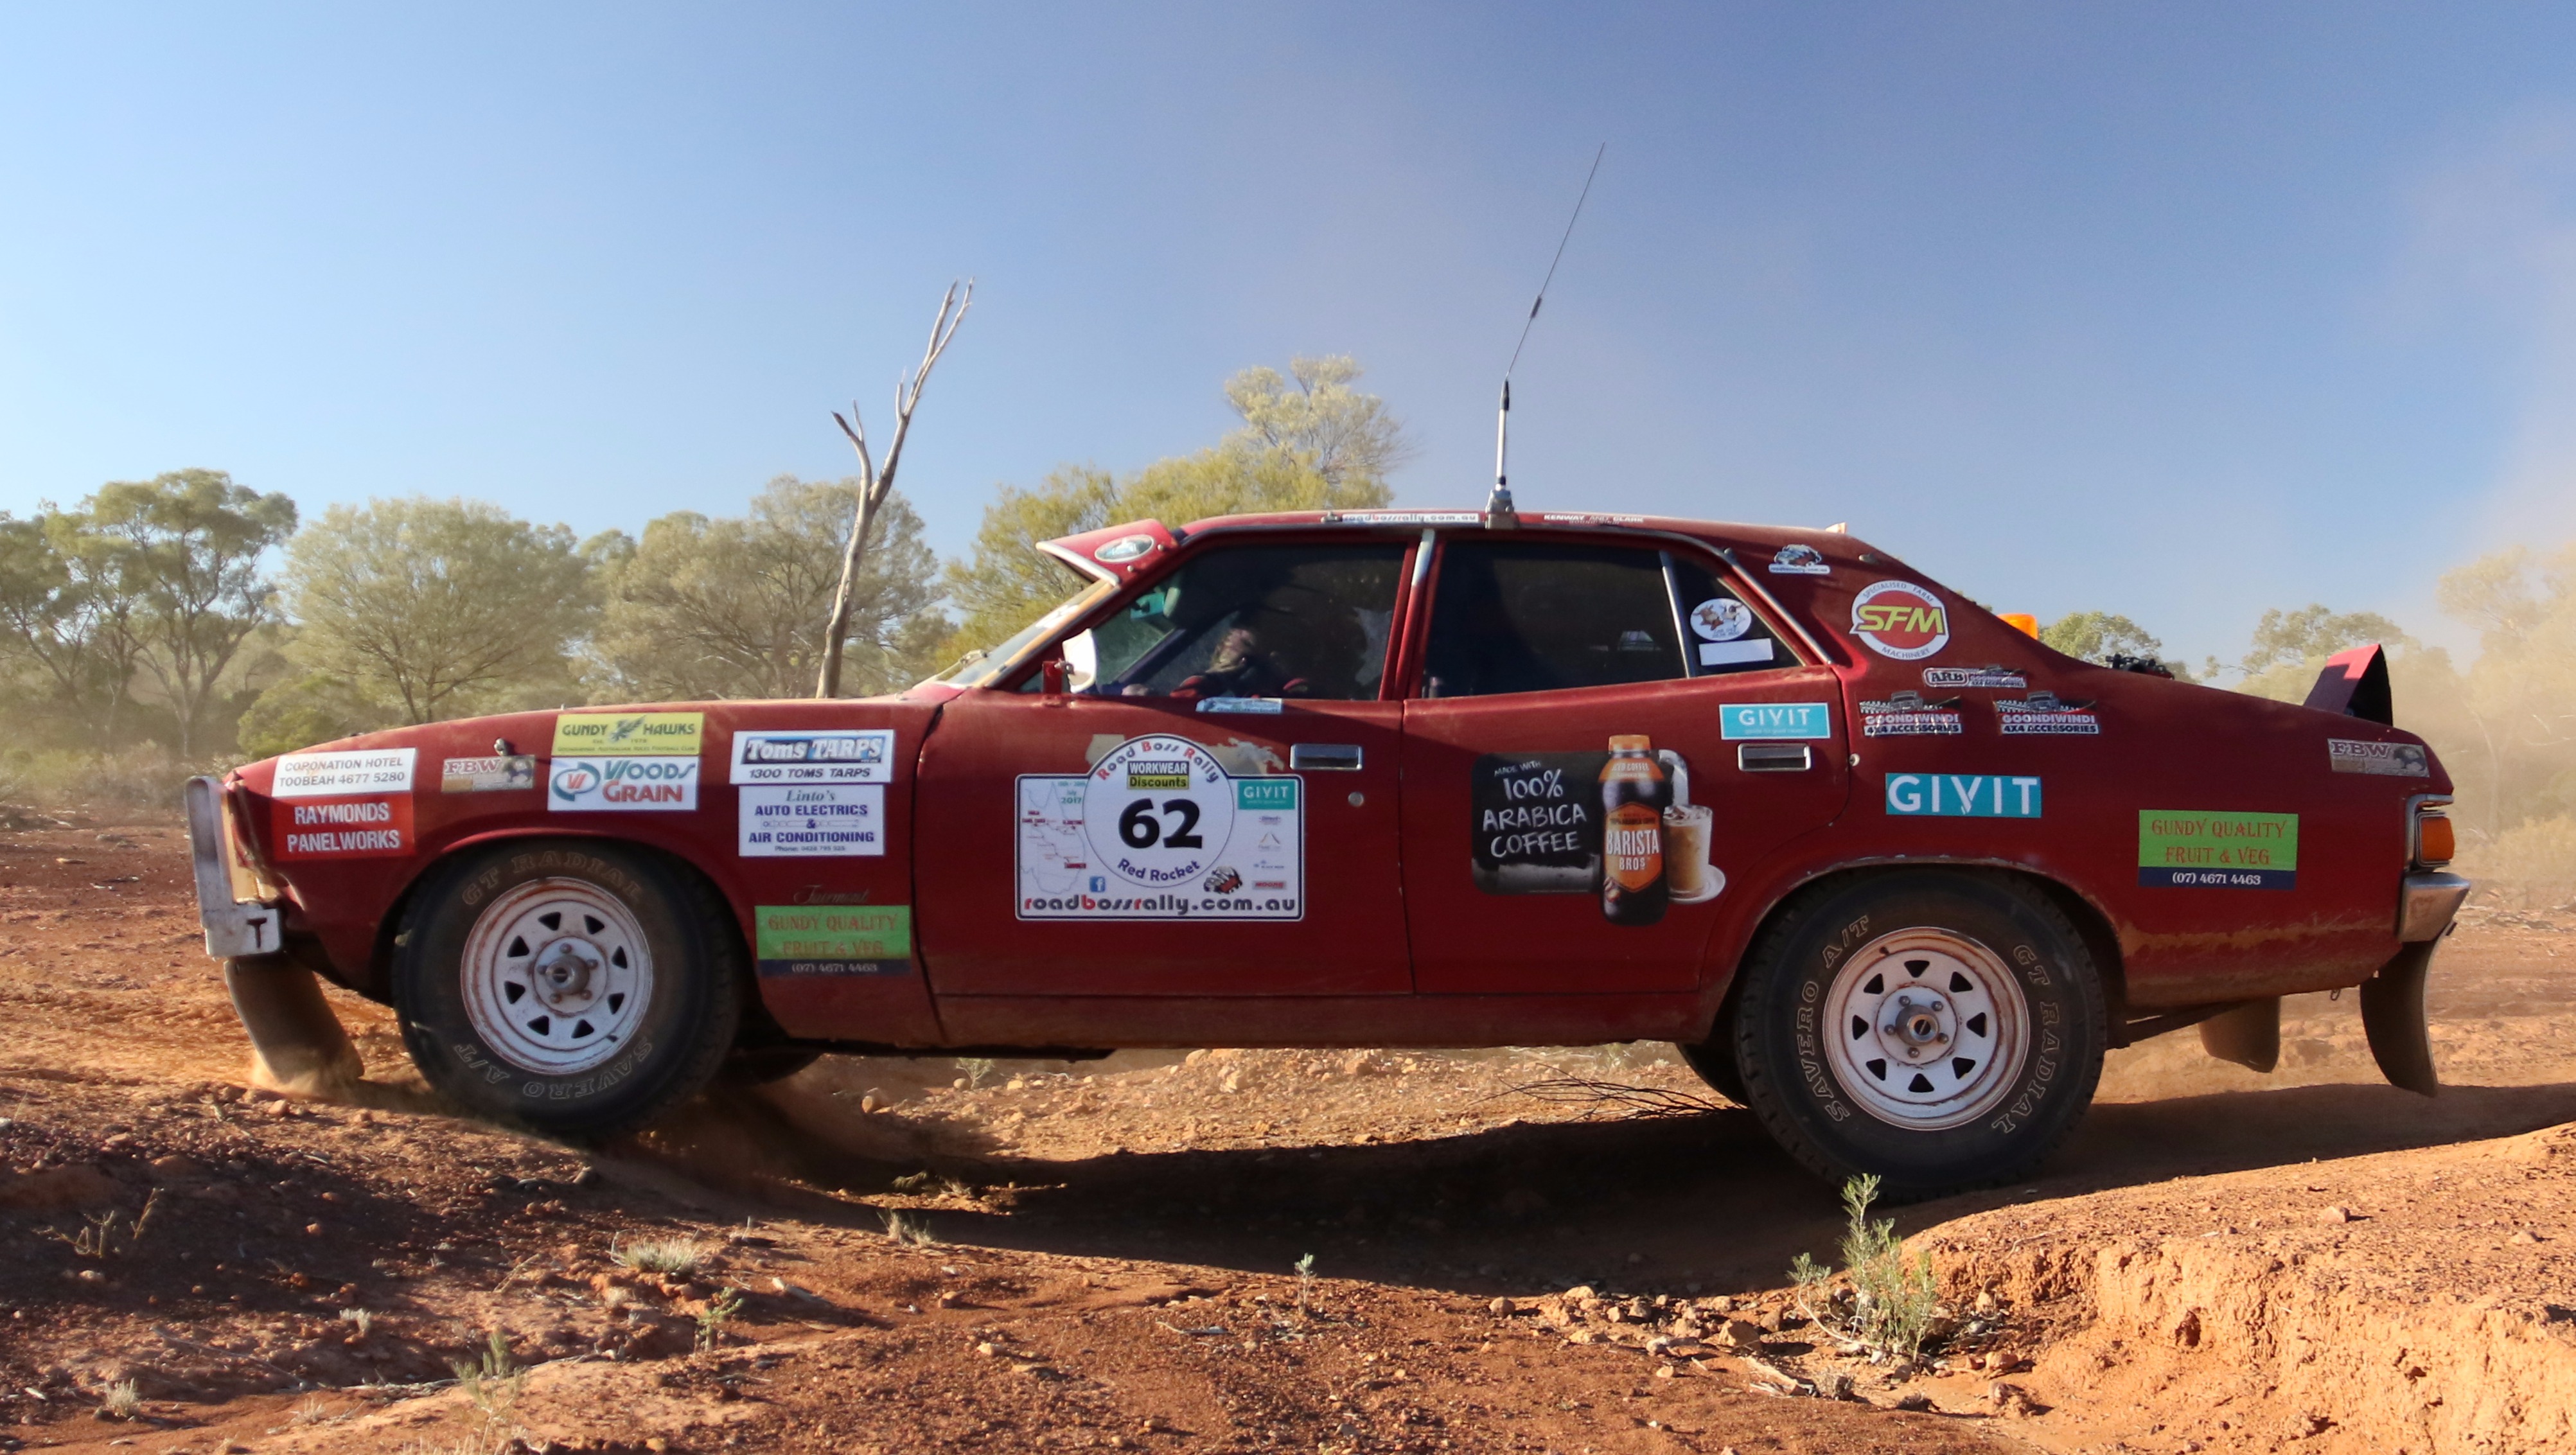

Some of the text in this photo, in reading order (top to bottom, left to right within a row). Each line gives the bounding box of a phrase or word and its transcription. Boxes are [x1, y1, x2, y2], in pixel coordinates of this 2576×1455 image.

[1863, 582, 1935, 602] SPECIALISED FARM
[1857, 604, 1945, 634] SFM
[1882, 646, 1930, 659] MACHINERY
[1930, 672, 1964, 683] ARB
[1738, 708, 1811, 727] GIVIT
[1865, 714, 1959, 724] GOONDIWINDI
[2002, 714, 2095, 724] GOONDIWINDI
[562, 724, 608, 736] GUNDY
[1867, 725, 1959, 734] 4X4 ACCESSORIES
[2027, 725, 2097, 734] ACCESSORIES
[746, 737, 883, 761] Toms TARPS
[2331, 741, 2389, 758] FBW
[285, 757, 403, 772] CORONATION HOTEL
[445, 758, 501, 775] FBW
[603, 760, 696, 780] WOODS
[1096, 741, 1220, 783] Road Boss Rally
[1129, 761, 1188, 775] WORKWEAR
[1494, 761, 1541, 777] MADE WITH
[279, 772, 405, 788] TOOBEAH 4677 5280
[750, 768, 870, 779] 1300 TOMS TARPS
[1129, 776, 1187, 788] Discounts
[603, 779, 684, 802] GRAIN
[1243, 786, 1289, 798] GIVIT
[1503, 769, 1564, 800] 100%
[786, 789, 835, 802] Linto's
[1888, 774, 2038, 816] GIVIT
[294, 802, 390, 824] RAYMONDS
[754, 805, 868, 816] AUTO ELECTRICS
[1483, 803, 1587, 832] ARABICA
[806, 818, 816, 829] &
[1118, 797, 1203, 850] 62
[2152, 818, 2288, 838] GUNDY QUALITY
[287, 829, 400, 853] PANELWORKS
[748, 832, 874, 843] AIR CONDITIONING
[1490, 831, 1582, 858] COFFEE
[1607, 829, 1660, 856] BARISTA
[1618, 856, 1646, 871] BROS
[2166, 846, 2270, 865] FRUIT & VEG
[462, 849, 642, 906] GT RADIAL
[1118, 858, 1201, 882] Red Rocket
[2172, 871, 2261, 885] (07) 4671 4463
[1024, 894, 1296, 915] roadbossrally.com.au
[768, 913, 898, 932] GUNDY QUALITY
[782, 939, 884, 956] FRUIT & VEG
[791, 963, 815, 973] (07)
[818, 963, 845, 973] 4671
[1797, 915, 1869, 1122] SAVERO A/T
[1991, 944, 2060, 1134] GT RADIAL
[454, 1037, 653, 1099] SAVERO A/T
